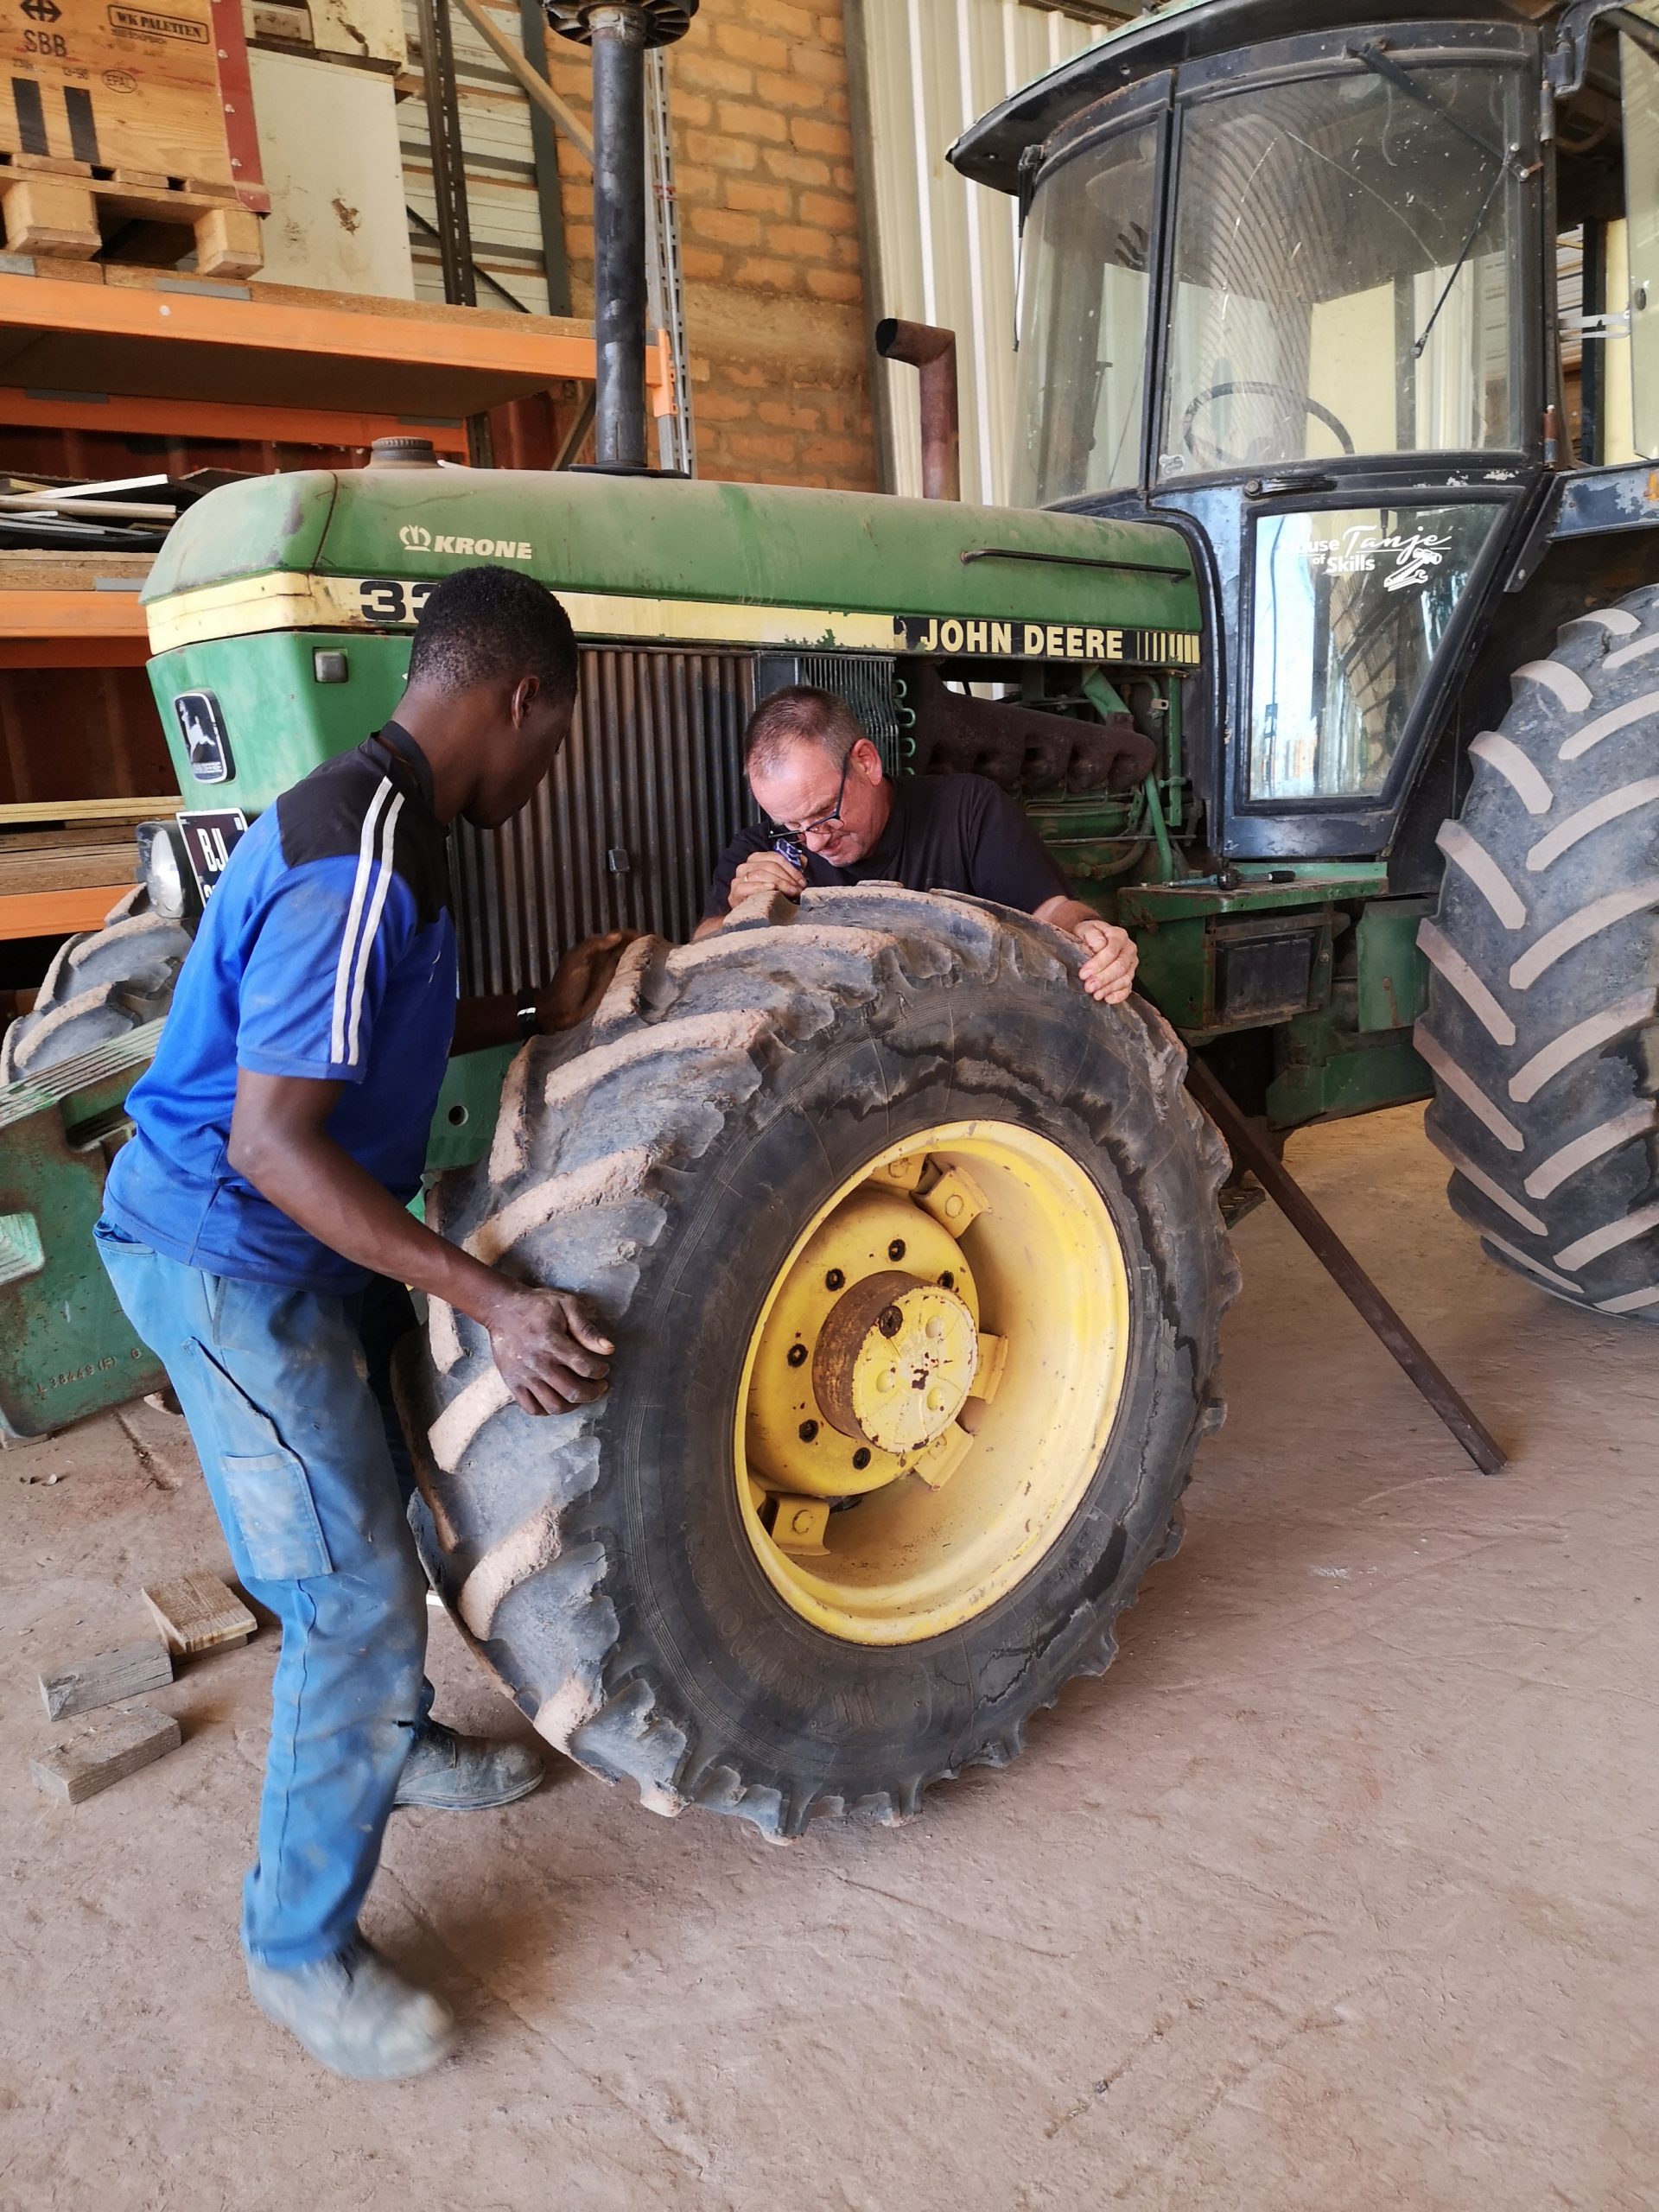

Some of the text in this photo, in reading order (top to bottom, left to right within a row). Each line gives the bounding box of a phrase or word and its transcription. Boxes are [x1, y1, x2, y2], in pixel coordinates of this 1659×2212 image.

[116, 11, 138, 26] WK
[140, 16, 201, 38] PALETTEN
[23, 29, 67, 57] SBB
[434, 535, 532, 560] KRONE
[1342, 524, 1452, 565] Tanje
[1312, 554, 1376, 573] of Skills
[920, 619, 1123, 659] JOHN DEERE
